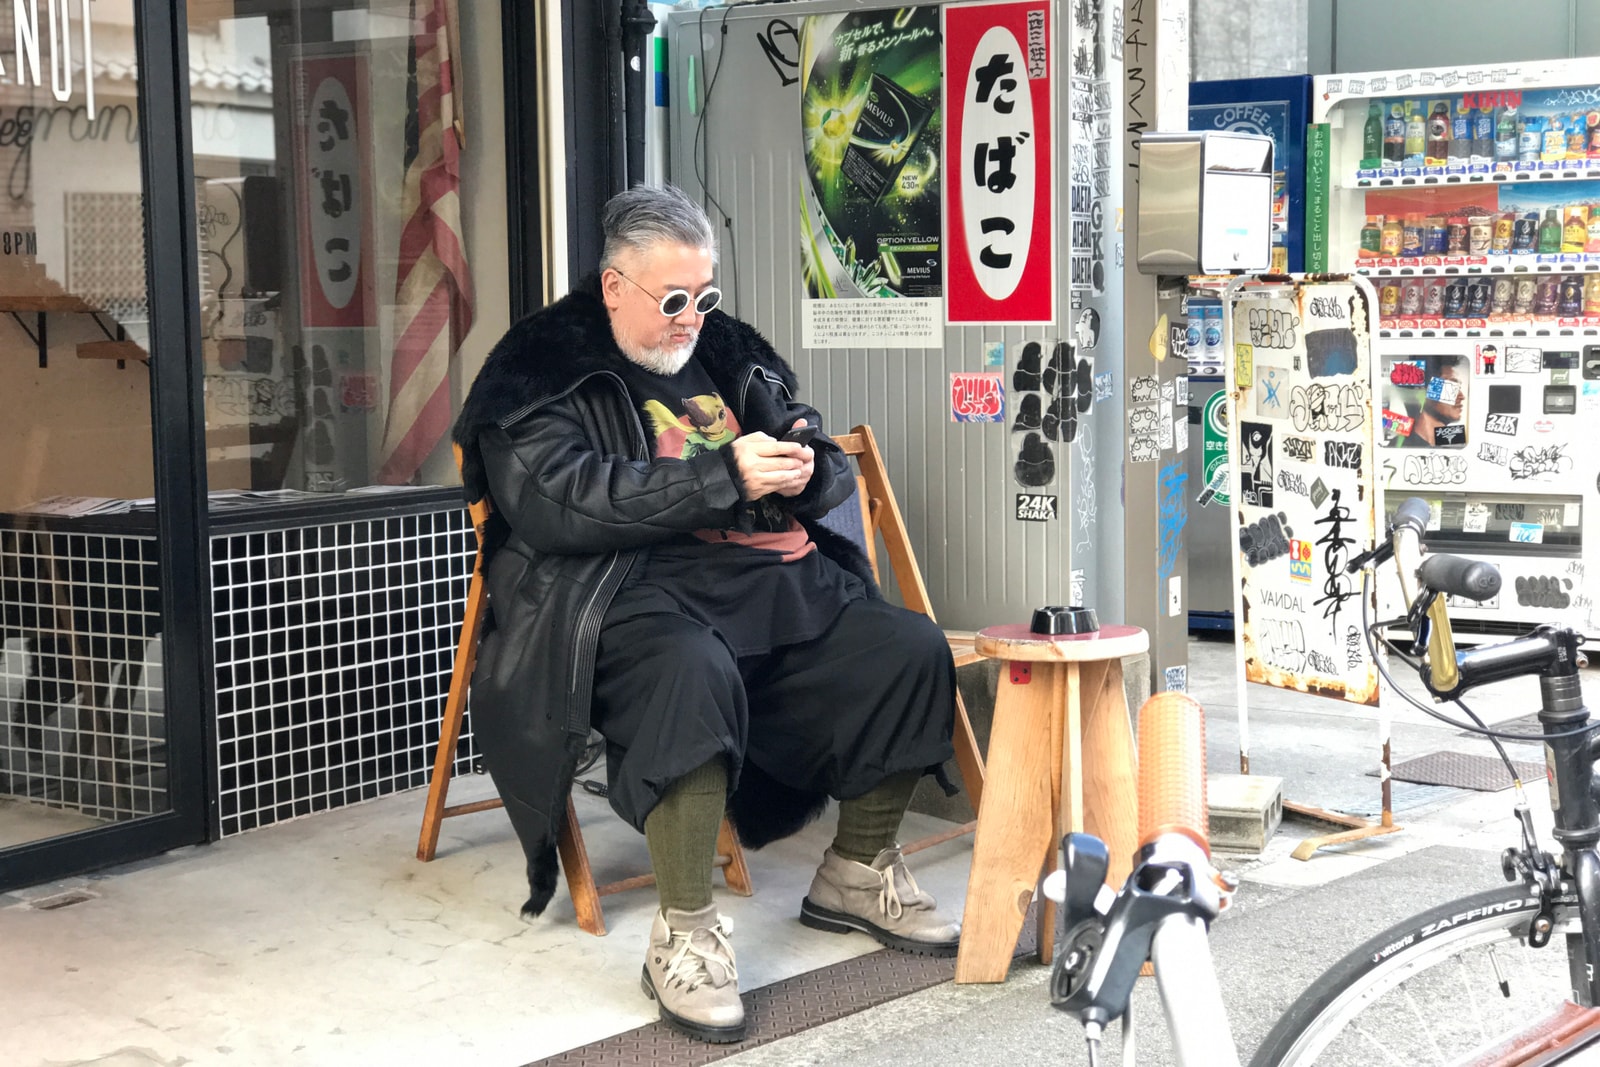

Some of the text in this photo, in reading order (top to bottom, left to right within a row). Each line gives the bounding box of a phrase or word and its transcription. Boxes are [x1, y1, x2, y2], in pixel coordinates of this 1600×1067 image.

[1463, 90, 1522, 109] KIRIN
[865, 101, 895, 128] MEVIUS
[1213, 105, 1271, 128] COFFEE
[974, 53, 1030, 269] たばこ
[1486, 423, 1516, 435] SHAKA
[1488, 414, 1518, 427] 24K
[1018, 495, 1056, 511] 24K
[1018, 509, 1055, 520] SHAKA
[1420, 899, 1523, 938] ZAFFIRO
